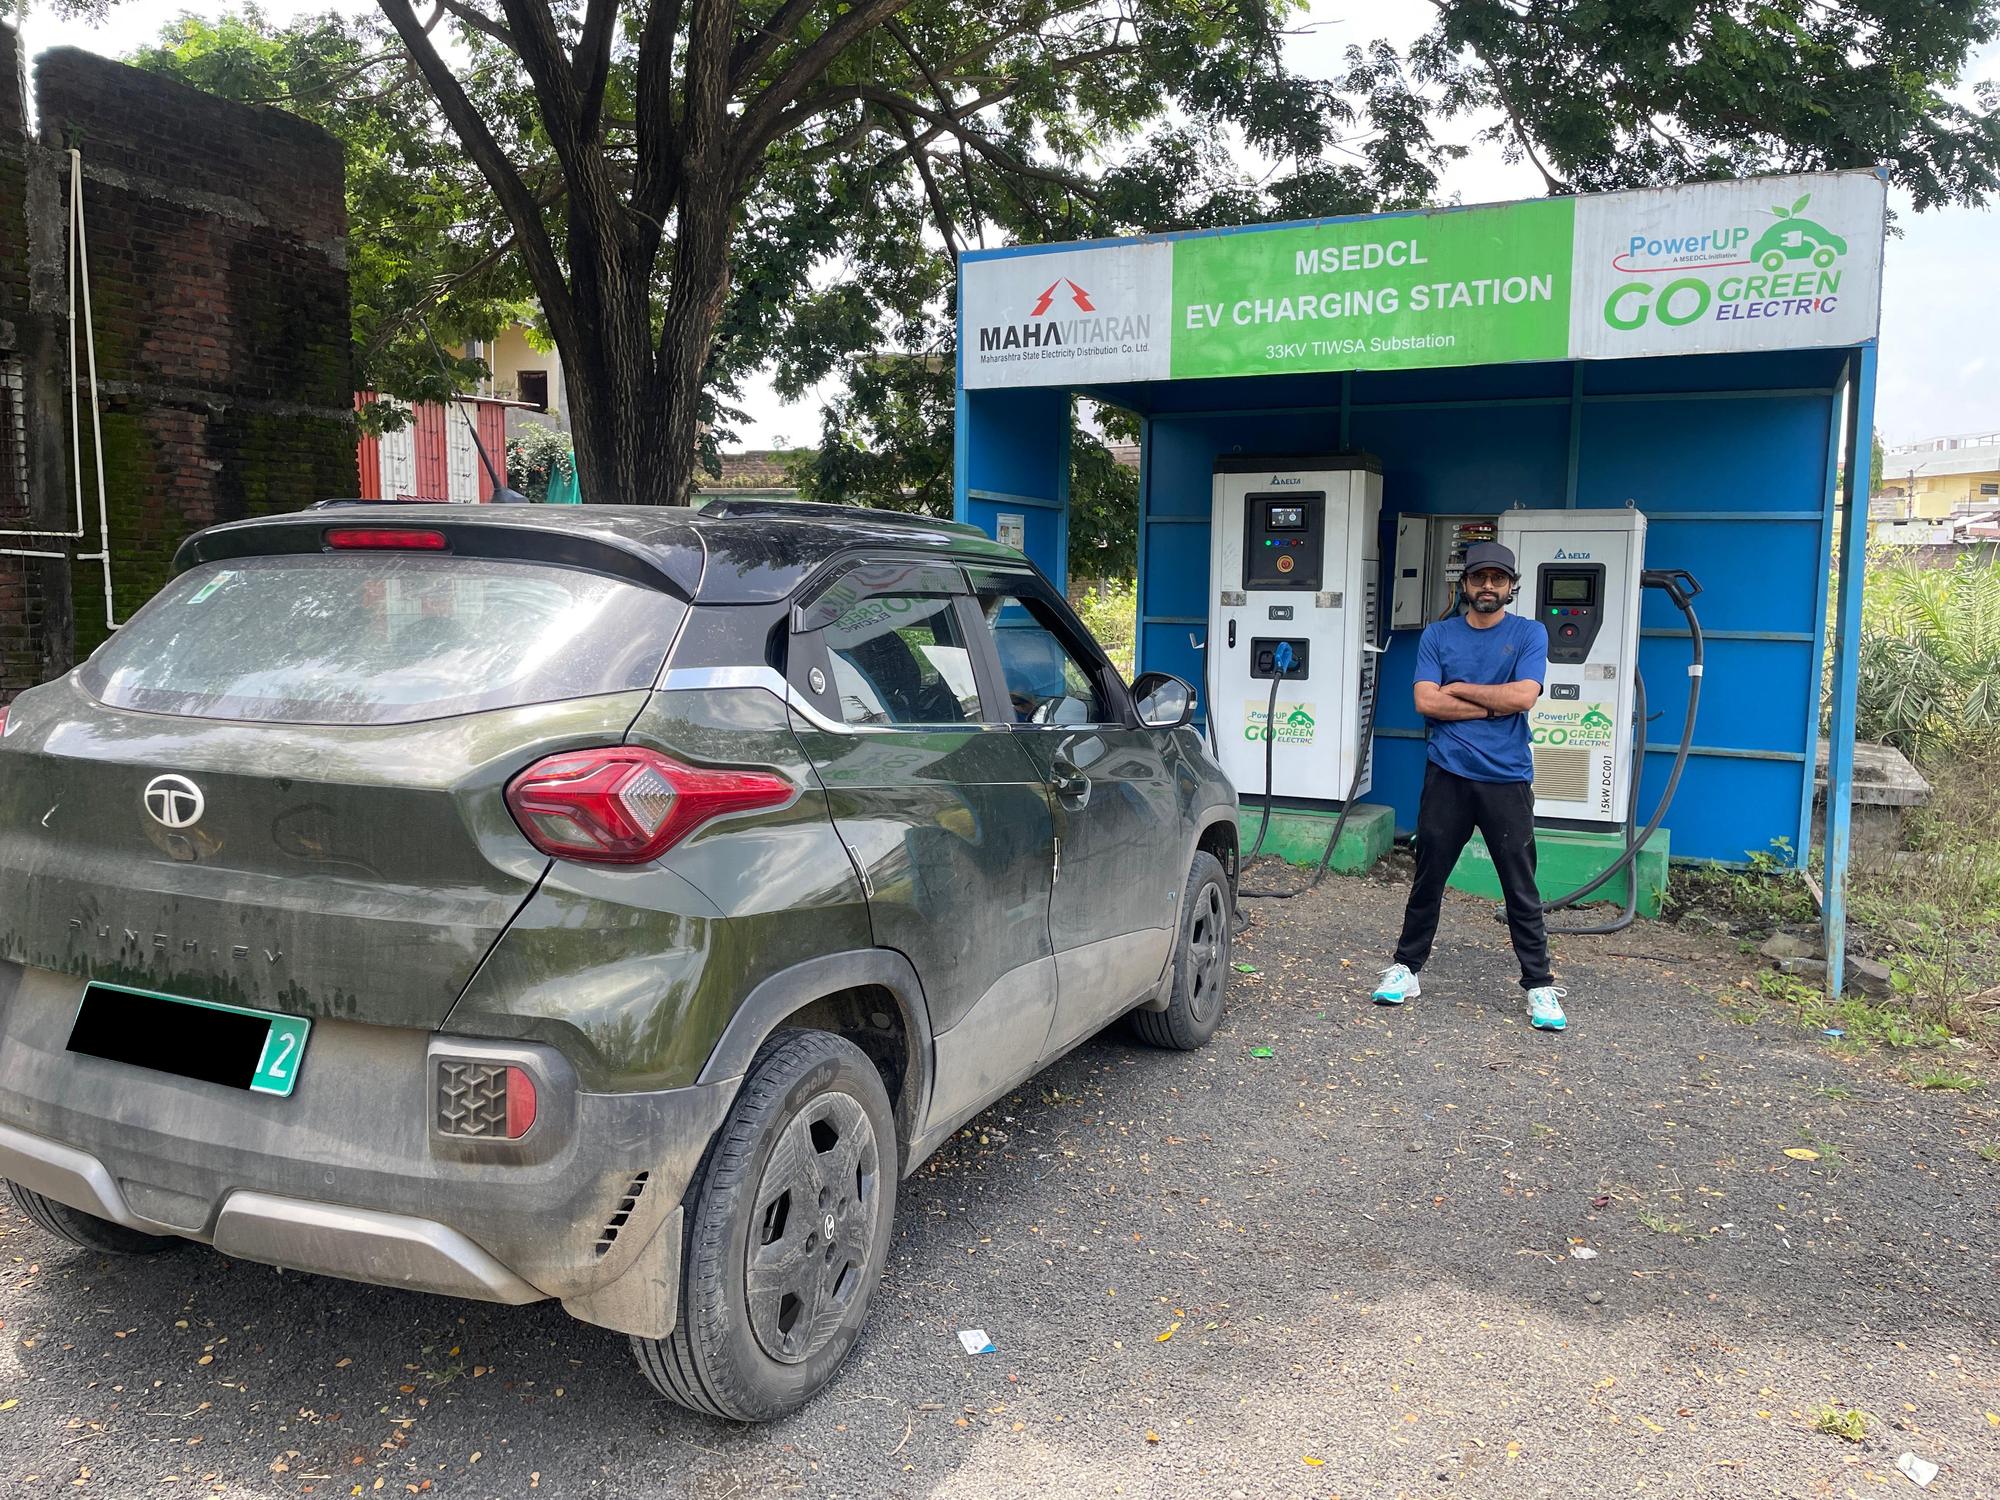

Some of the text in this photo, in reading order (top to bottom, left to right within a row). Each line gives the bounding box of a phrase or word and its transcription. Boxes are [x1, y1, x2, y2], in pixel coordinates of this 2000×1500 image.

[1629, 228, 1750, 258] PowerUP
[1295, 240, 1428, 275] MSEDCL
[1186, 274, 1553, 329] EV CHARGING STATION
[1604, 270, 1842, 330] GO GREEN
[1715, 296, 1838, 321] ELECTRIC
[980, 313, 1150, 351] MAHAVITARAN
[980, 343, 1150, 364] Maharashtra State Electricity Distribution Co. Ltd.
[1265, 333, 1455, 360] 33KV TIWSA Substation
[1568, 552, 1591, 560] DELTA
[1537, 712, 1581, 720] PowerUP
[1277, 736, 1313, 744] ELECTRIC
[1278, 727, 1314, 737] GREEN
[1532, 727, 1612, 745] GO GREEN
[1568, 739, 1610, 747] ELECTRIC
[1601, 755, 1612, 813] 15kW DC001
[796, 1066, 832, 1104] apollo
